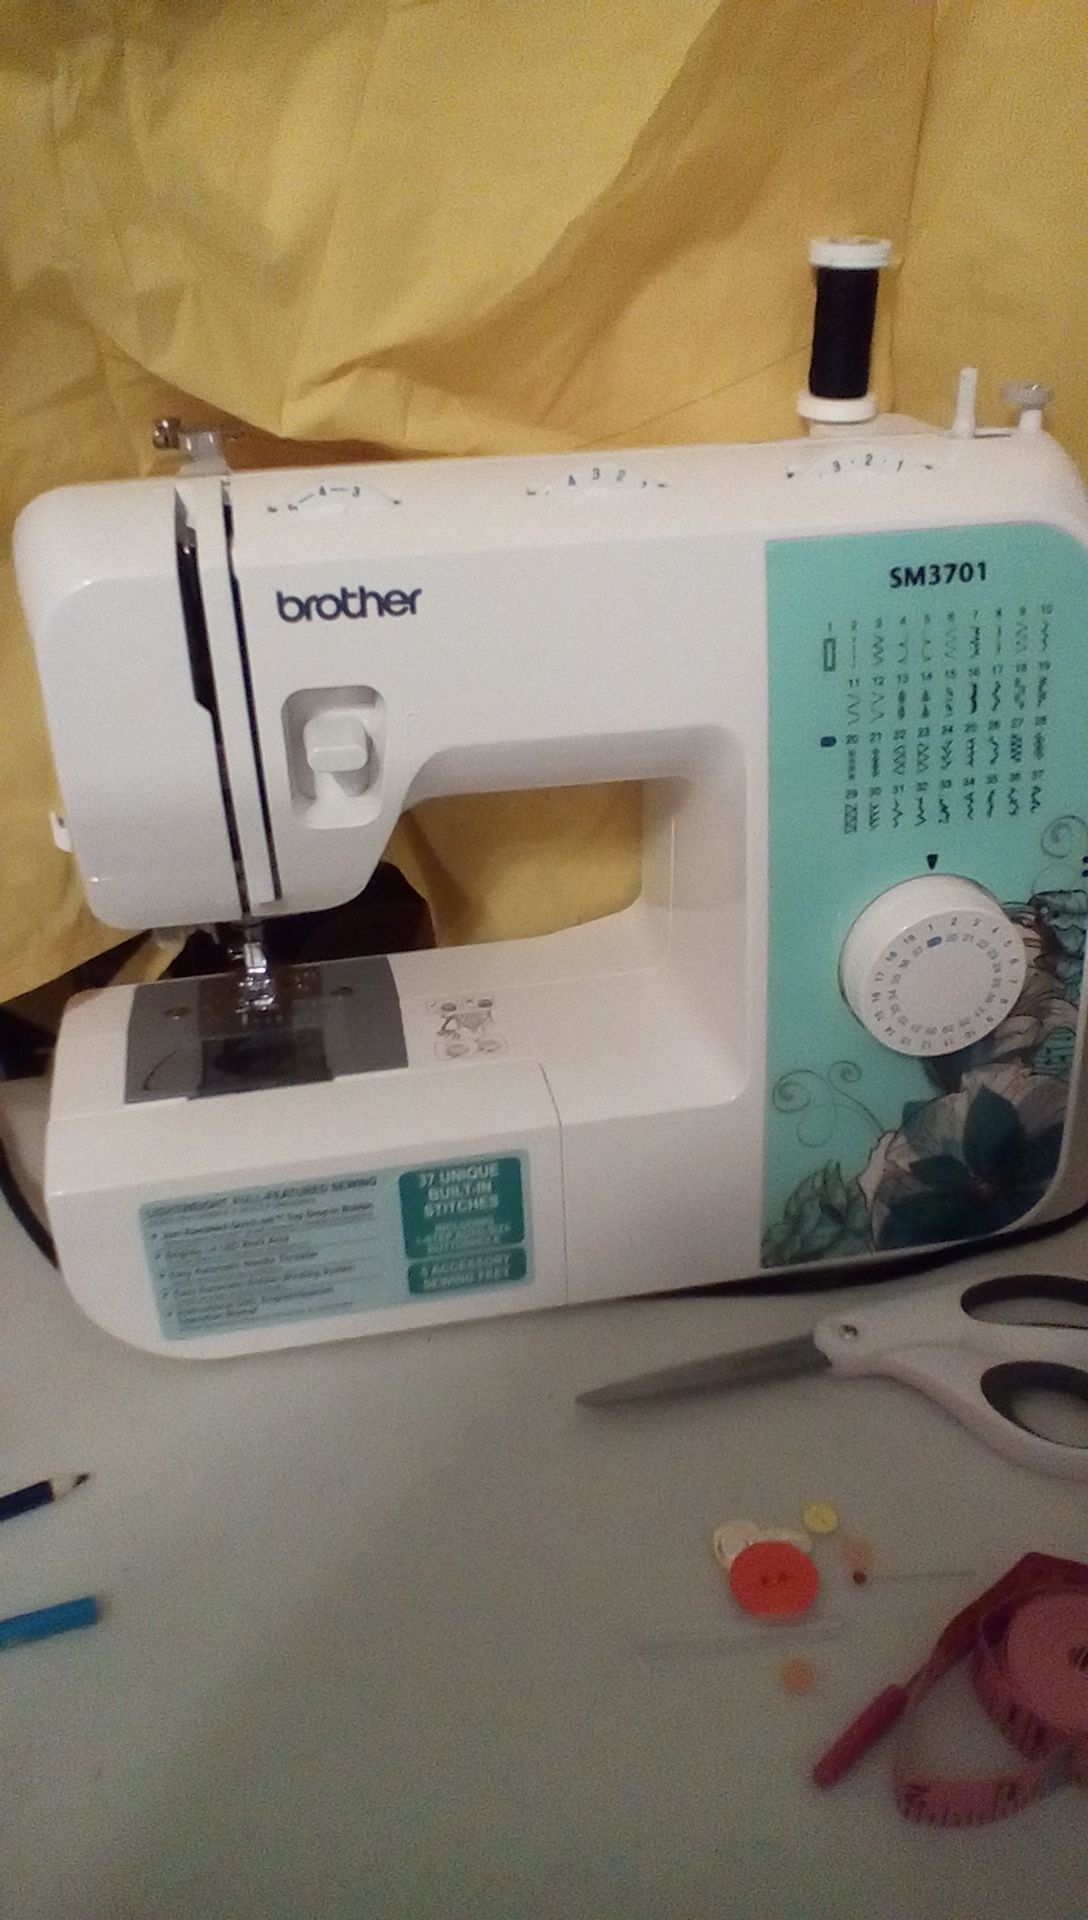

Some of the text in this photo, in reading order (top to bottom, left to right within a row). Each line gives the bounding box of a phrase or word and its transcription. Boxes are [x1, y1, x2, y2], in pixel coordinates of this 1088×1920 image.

[889, 560, 987, 589] SM3701
[276, 585, 423, 623] brother
[438, 1163, 500, 1184] UNIQUE
[424, 1195, 499, 1217] STITCHES
